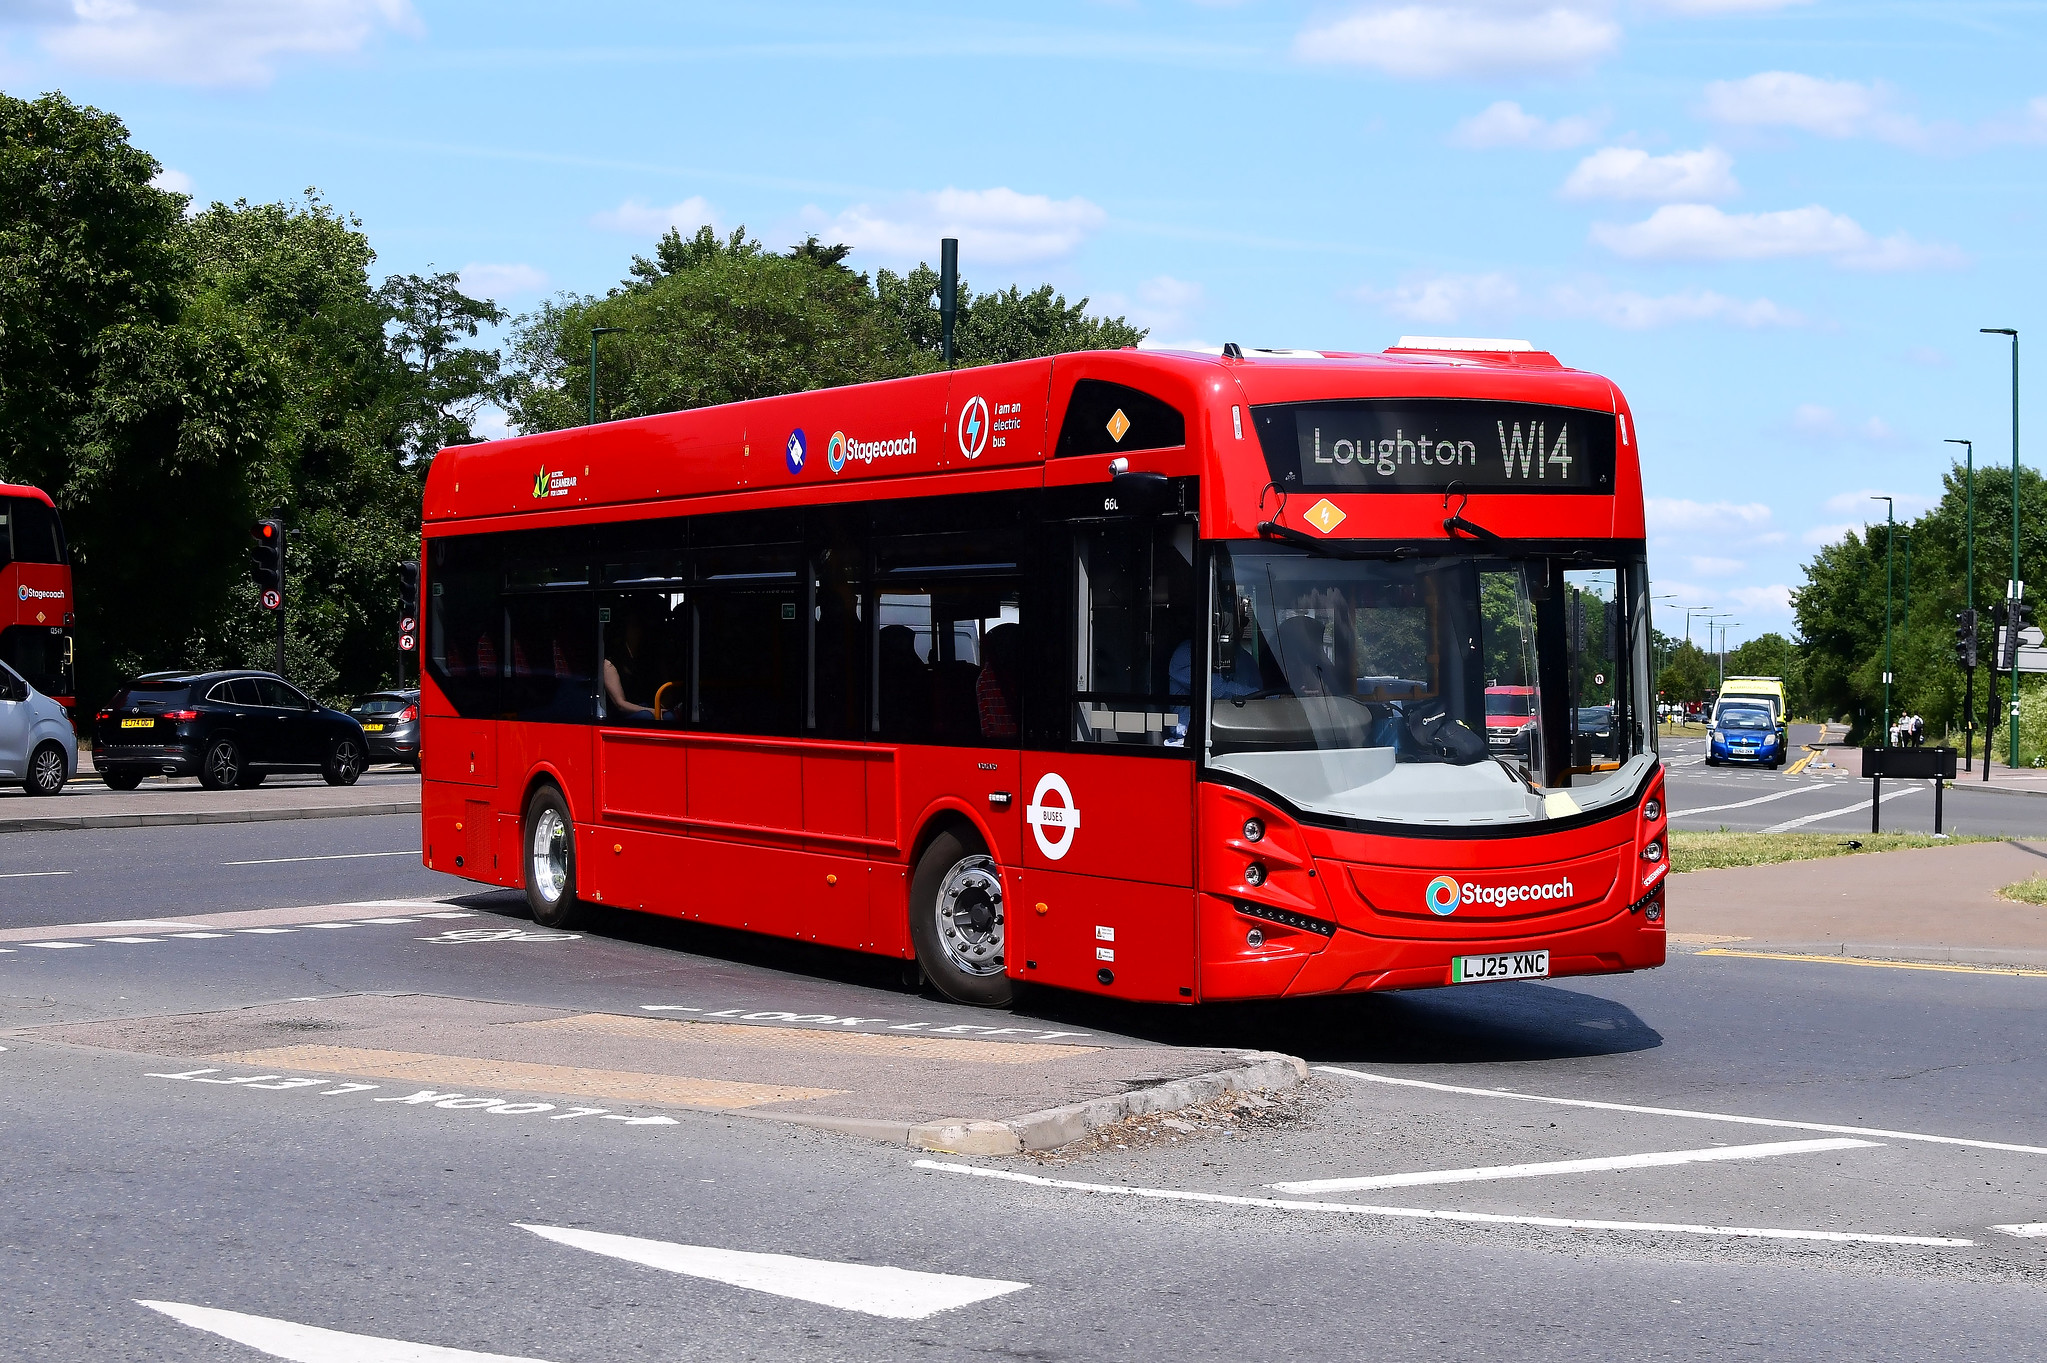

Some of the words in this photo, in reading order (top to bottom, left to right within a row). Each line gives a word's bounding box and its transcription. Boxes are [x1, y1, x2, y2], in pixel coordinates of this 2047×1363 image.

[994, 402, 998, 415] I
[999, 404, 1011, 415] am
[1011, 402, 1021, 414] an
[993, 416, 1021, 431] electric
[846, 430, 917, 465] Stagecoach
[992, 435, 1006, 448] bus
[1314, 427, 1476, 476] Loughton
[1496, 419, 1573, 479] W14
[28, 587, 65, 600] Stagecoach
[1043, 810, 1063, 822] BUSES
[1461, 876, 1574, 908] Stagecoach
[1463, 956, 1509, 978] LJ25
[1512, 954, 1545, 975] XNC
[703, 1008, 889, 1026] LOOK
[887, 1021, 1093, 1040] LEFT
[143, 1068, 381, 1096] LEFT
[372, 1089, 613, 1121] LOOK
